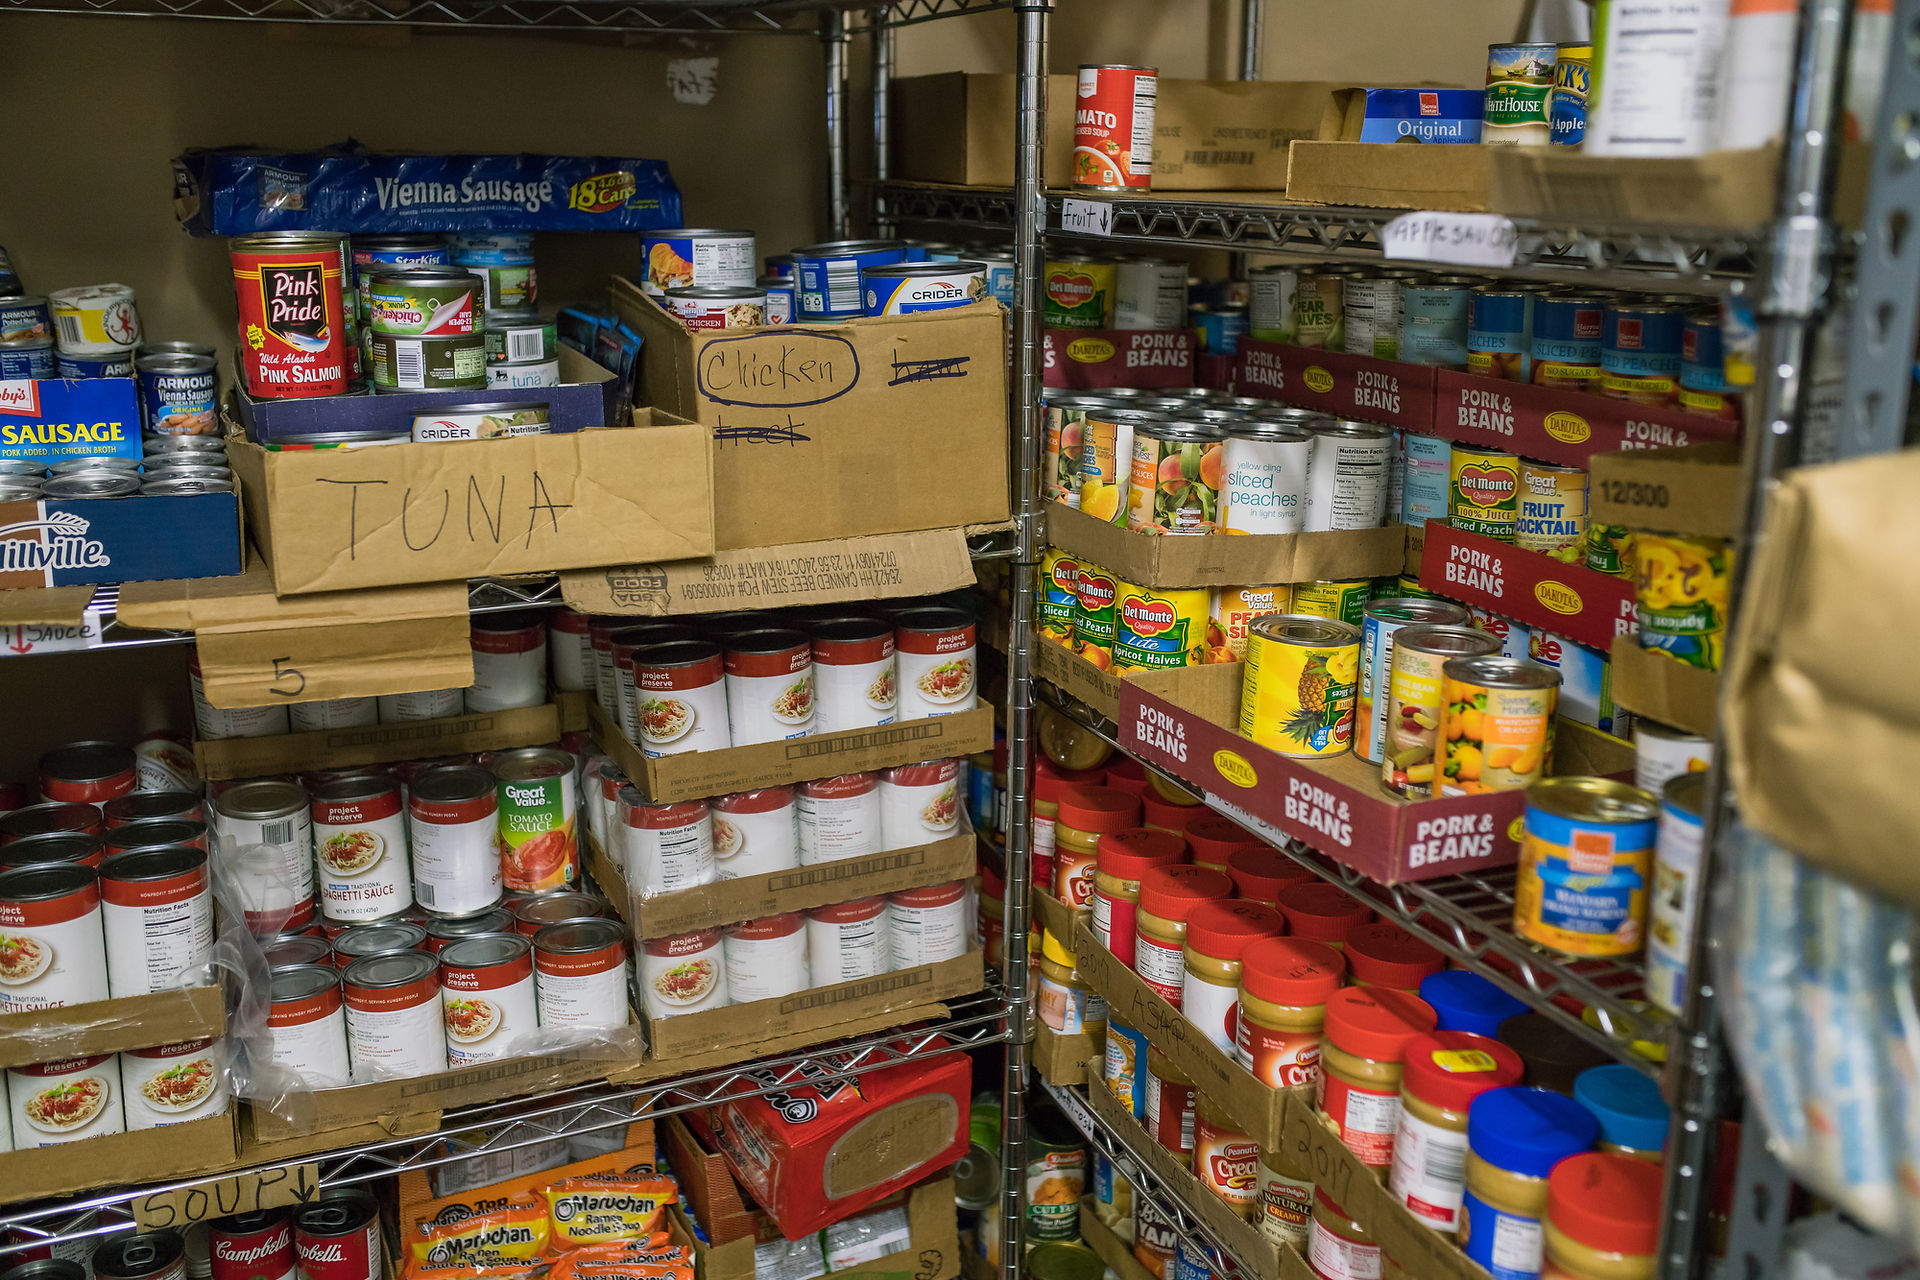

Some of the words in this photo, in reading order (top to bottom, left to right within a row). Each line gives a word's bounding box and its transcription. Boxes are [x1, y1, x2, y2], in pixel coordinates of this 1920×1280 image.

[1556, 64, 1590, 92] CK'S
[1076, 109, 1117, 129] MATO
[1092, 128, 1110, 138] SOUP
[1397, 120, 1462, 140] Original
[264, 169, 301, 182] ARMOUR
[375, 177, 456, 211] Vienna
[461, 177, 552, 213] Sausage
[568, 182, 597, 210] 18
[599, 186, 637, 205] Cans
[1064, 203, 1096, 228] Fruit
[395, 254, 440, 265] StarKist
[273, 270, 320, 297] Pink
[1049, 281, 1060, 291] Del
[1062, 282, 1093, 294] Monte
[912, 289, 963, 300] CRIDER
[1, 310, 37, 319] ARMOUR
[271, 297, 321, 323] Pride
[688, 319, 721, 327] CHICKEN
[1131, 335, 1174, 348] PORK
[1177, 336, 1187, 348] &
[259, 352, 279, 364] Wild
[281, 352, 316, 365] Alaska
[1127, 350, 1188, 367] BEANS
[1247, 351, 1274, 369] PORK
[1274, 356, 1282, 369] &
[259, 365, 290, 383] PINK
[292, 364, 341, 384] SALMON
[706, 344, 833, 391] Chicken
[158, 375, 213, 389] ARMOUR
[512, 373, 542, 387] tuna
[1245, 365, 1284, 389] BEANS
[1357, 371, 1388, 391] PORK
[1390, 378, 1399, 393] &
[158, 389, 186, 401] Vienna
[1354, 387, 1401, 414] BEANS
[1461, 388, 1499, 409] PORK
[1501, 397, 1512, 413] &
[1457, 407, 1515, 437] BEANS
[2, 422, 125, 445] SAUSAGE
[421, 428, 471, 440] CRIDER
[510, 427, 539, 435] Nutrition
[1625, 420, 1674, 447] PORK
[1675, 430, 1689, 448] &
[62, 446, 92, 455] CHICKEN
[94, 446, 117, 454] BROTH
[1339, 447, 1368, 455] Nutrition
[1136, 468, 1154, 480] SLICES
[1238, 461, 1261, 471] yellow
[1263, 462, 1282, 472] cling
[1228, 471, 1274, 489] sliced
[1462, 475, 1476, 488] Del
[1478, 478, 1514, 491] Monte
[1524, 471, 1557, 488] Great
[1472, 491, 1496, 502] Quality
[1530, 485, 1556, 497] Value
[1600, 479, 1669, 508] 12/300
[1230, 490, 1298, 508] peaches
[316, 470, 573, 560] TUNA
[1250, 508, 1258, 516] in
[1259, 508, 1276, 519] light
[1278, 510, 1296, 519] syrup
[1459, 507, 1482, 519] 100%
[1484, 508, 1512, 520] JUICE
[1522, 501, 1565, 518] FRUIT
[1451, 517, 1475, 532] Sliced
[1516, 517, 1580, 536] COCKTAIL
[1450, 544, 1491, 569] PORK
[1492, 558, 1503, 576] &
[703, 563, 736, 581] 100526
[738, 561, 766, 579] MAT#
[767, 560, 774, 577] K
[1056, 567, 1070, 580] Del
[613, 578, 662, 588] FOOD
[762, 577, 789, 595] STEW
[791, 574, 816, 593] BEEF
[817, 571, 858, 590] CANNED
[859, 571, 873, 587] HH
[1445, 561, 1505, 598] BEANS
[738, 580, 761, 597] PO#
[1086, 584, 1114, 599] Monte
[1240, 590, 1274, 603] Great
[1541, 586, 1580, 610] DAKOTA'S
[1044, 604, 1070, 618] Sliced
[1248, 601, 1273, 610] Value
[1125, 605, 1138, 619] Del
[1139, 609, 1173, 624] Monte
[1134, 621, 1155, 632] Quality
[936, 639, 967, 651] preserve
[938, 633, 965, 645] project
[1127, 635, 1161, 650] Lite
[1114, 644, 1143, 662] Apricot
[1147, 652, 1181, 666] Halves
[270, 656, 305, 697] 5
[641, 679, 673, 688] preserve
[642, 671, 670, 682] project
[1412, 682, 1436, 693] BEAN
[1140, 703, 1174, 733] PORK
[1176, 722, 1186, 741] &
[1136, 720, 1188, 763] BEANS
[505, 785, 545, 800] Great
[1289, 777, 1335, 811] PORK
[1338, 801, 1350, 821] &
[515, 798, 545, 807] Value
[328, 813, 363, 822] preserve
[329, 805, 360, 817] project
[508, 812, 553, 823] TOMATO
[509, 820, 553, 833] SAUCE
[1284, 794, 1353, 848] BEANS
[1417, 816, 1476, 842] PORK
[1478, 814, 1494, 832] &
[659, 828, 683, 837] Nutrition
[684, 825, 697, 834] Facts
[1408, 832, 1496, 868] BEANS
[323, 887, 362, 902] SPAGHETTI
[364, 884, 394, 900] SAUCE
[350, 881, 381, 890] TRADITIONAL
[144, 906, 173, 915] Nutrition
[174, 902, 189, 910] Facts
[839, 922, 861, 930] Nutrition
[668, 941, 703, 955] preserve
[670, 935, 700, 948] project
[447, 979, 479, 988] preserve
[448, 971, 475, 981] project
[404, 993, 419, 1001] PEOPLE
[288, 1010, 306, 1018] HUNGRY
[306, 1006, 321, 1014] PEOPLE
[161, 1040, 202, 1056] preserve
[43, 1058, 88, 1074] preserve
[1228, 1147, 1252, 1156] Peanut
[144, 1167, 287, 1228] SOUP
[1287, 1187, 1305, 1198] Delight
[572, 1194, 656, 1213] Maruchan
[1264, 1192, 1310, 1214] NATURAL
[585, 1213, 623, 1224] Ramen
[1269, 1205, 1301, 1223] CREAMY
[568, 1223, 611, 1236] Noodle
[446, 1226, 532, 1254] Maruchan
